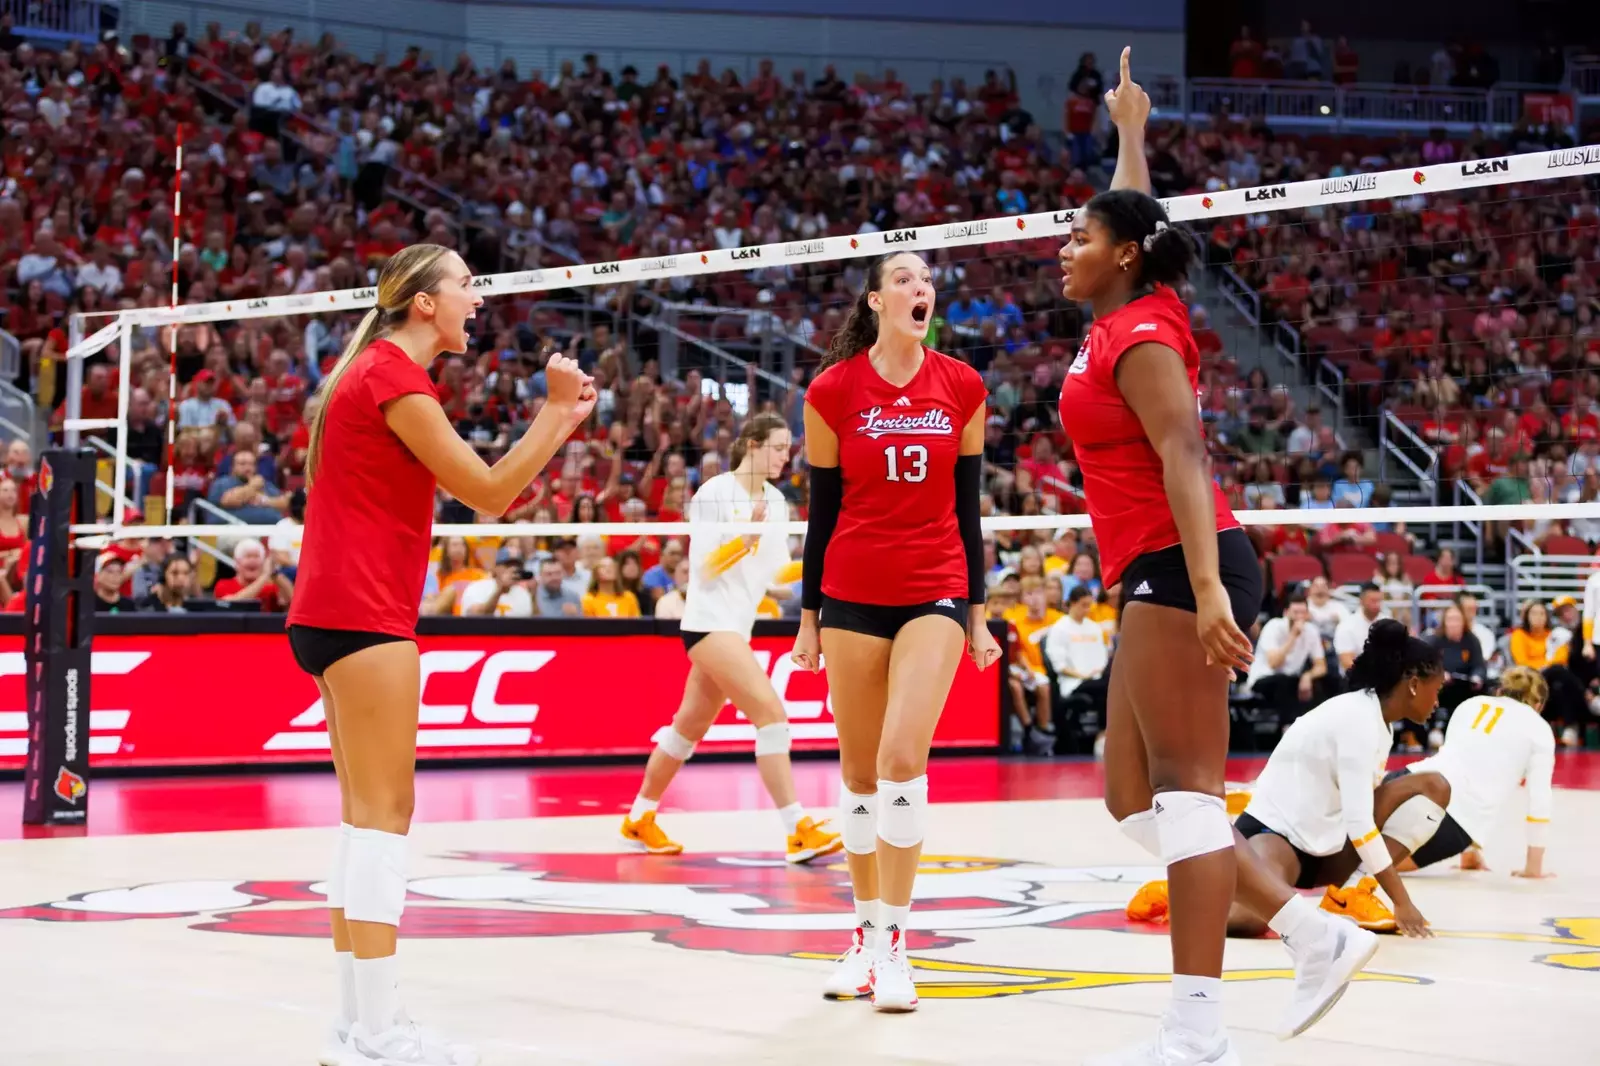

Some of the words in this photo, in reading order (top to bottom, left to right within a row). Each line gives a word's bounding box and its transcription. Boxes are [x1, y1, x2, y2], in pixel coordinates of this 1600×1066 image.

[1547, 147, 1600, 168] LOUISVIL
[1461, 158, 1509, 176] L&N
[1245, 187, 1287, 202] L&N
[1320, 175, 1377, 196] LOUISVILLE
[1053, 211, 1074, 224] L&
[884, 230, 917, 244] L&N
[943, 222, 988, 240] LOUISVILLE
[731, 248, 761, 260] L&N
[593, 263, 620, 275] L&N
[473, 277, 493, 287] &N
[857, 406, 953, 438] Louisville
[884, 444, 929, 482] 13
[289, 650, 557, 725] CC
[1471, 703, 1505, 735] 11
